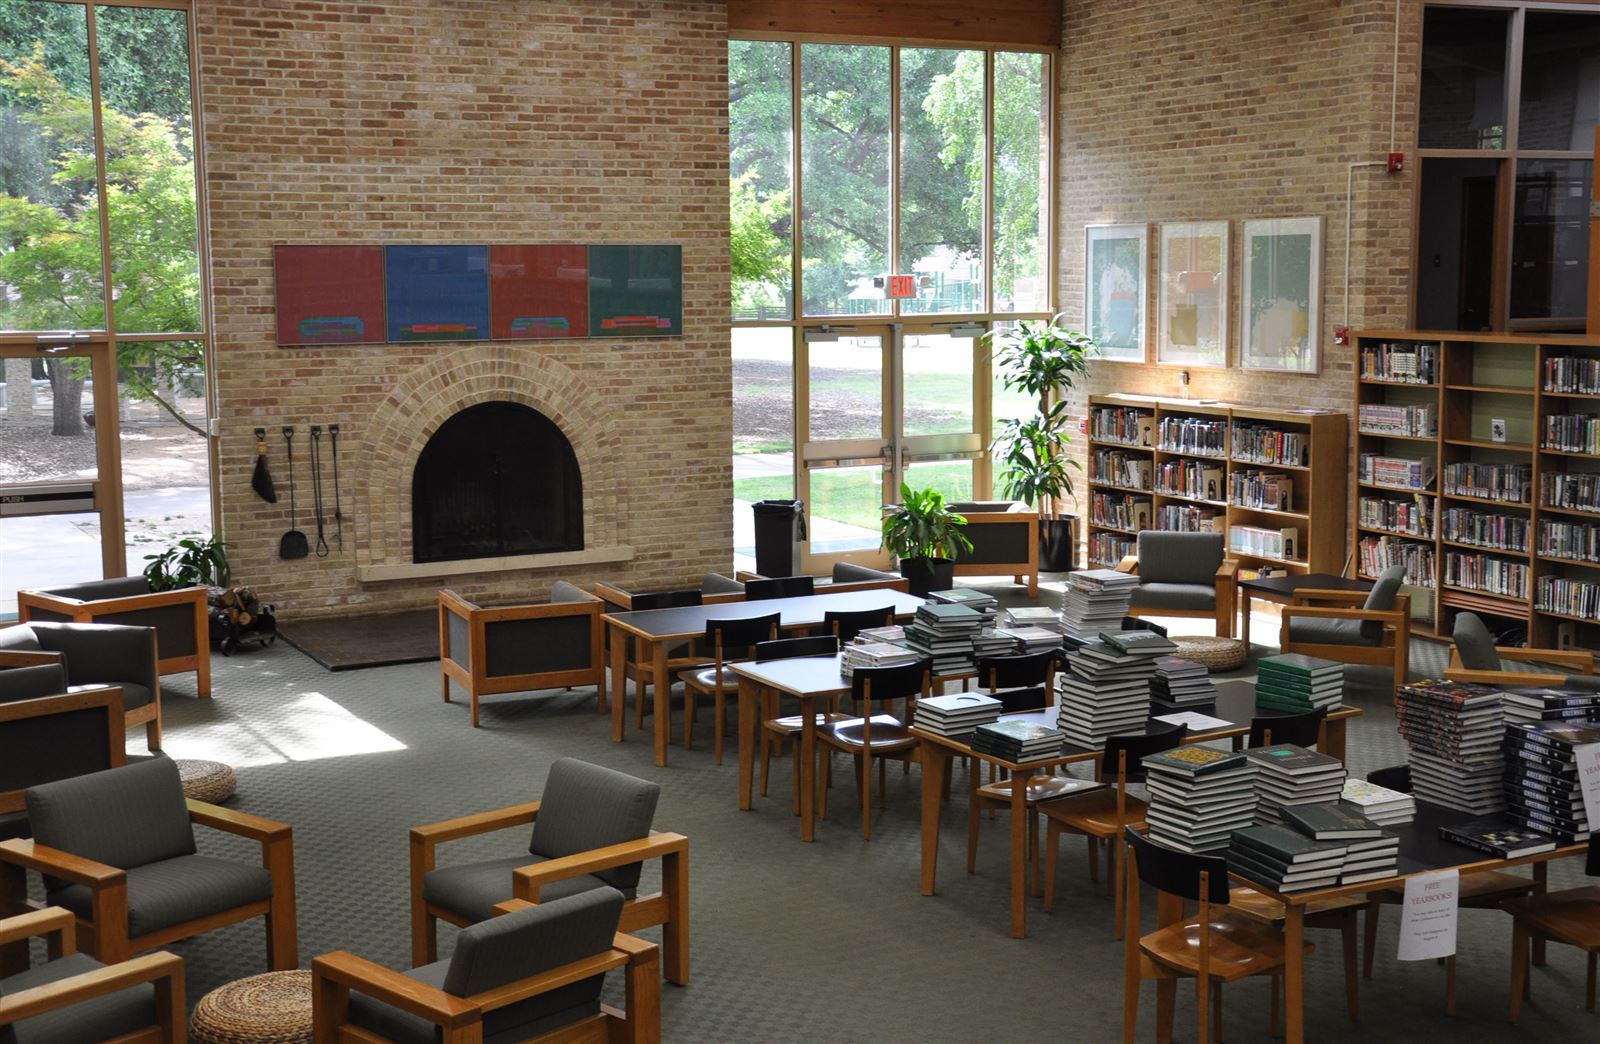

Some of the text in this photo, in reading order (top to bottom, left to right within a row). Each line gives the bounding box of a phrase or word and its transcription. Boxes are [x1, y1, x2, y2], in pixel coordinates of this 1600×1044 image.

[891, 276, 912, 297] EXIT
[2, 495, 24, 503] PUSH
[1424, 882, 1440, 891] FREE
